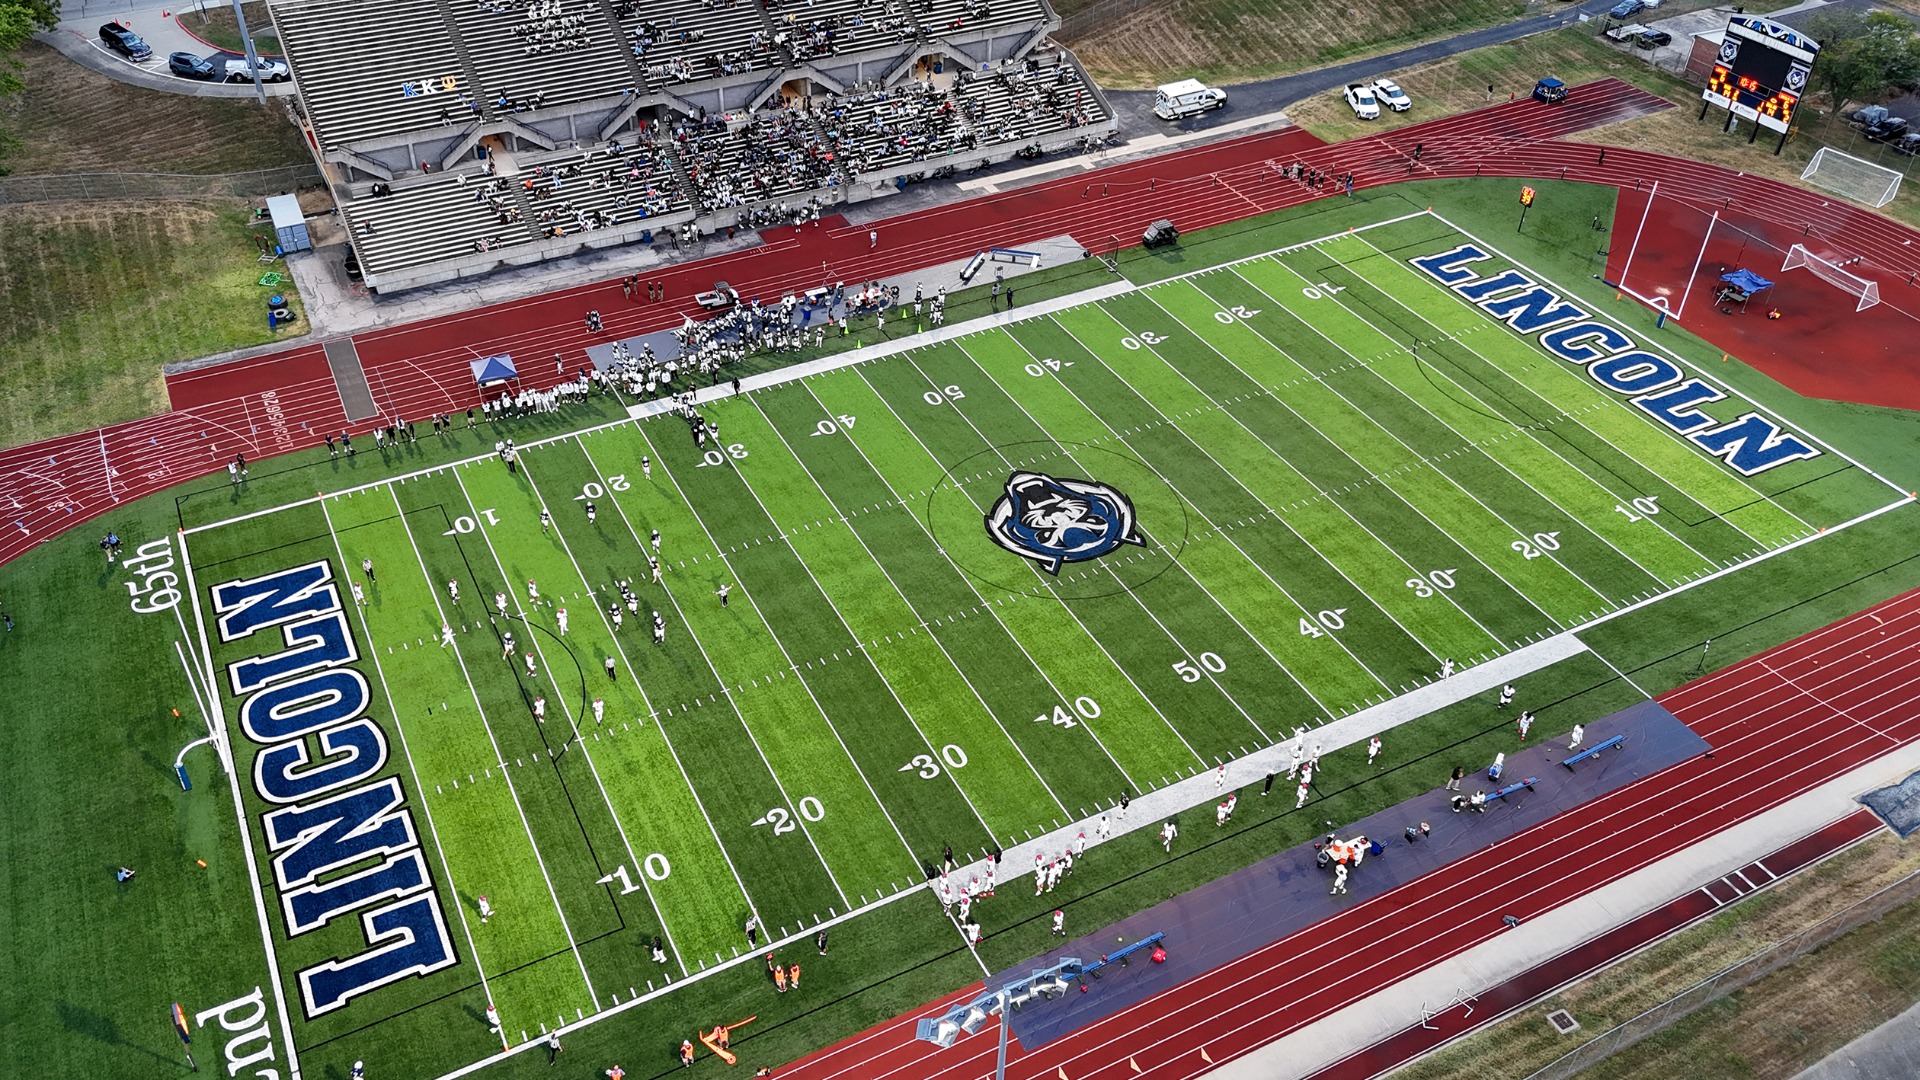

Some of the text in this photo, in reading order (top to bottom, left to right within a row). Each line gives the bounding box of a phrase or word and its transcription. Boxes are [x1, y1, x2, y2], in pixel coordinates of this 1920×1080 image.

[1302, 282, 1339, 300] 10
[1213, 305, 1253, 325] 20
[1120, 331, 1160, 350] 30
[1024, 358, 1061, 378] 40
[1407, 243, 1824, 478] LINCOLN
[923, 385, 966, 406] 50
[815, 414, 857, 437] 40
[704, 443, 749, 467] 30
[583, 474, 631, 500] 20
[451, 508, 501, 536] 10
[1614, 496, 1660, 523] 10
[1510, 532, 1561, 561] 20
[122, 535, 182, 614] 65th
[1405, 569, 1457, 599] 30
[1299, 609, 1346, 640] 40
[1171, 651, 1227, 684] 50
[1052, 695, 1102, 730] 40
[910, 743, 969, 780] 30
[209, 559, 460, 1021] LINCOLN
[766, 796, 826, 837] 20
[610, 852, 672, 896] 10
[195, 985, 280, 1080] nd
